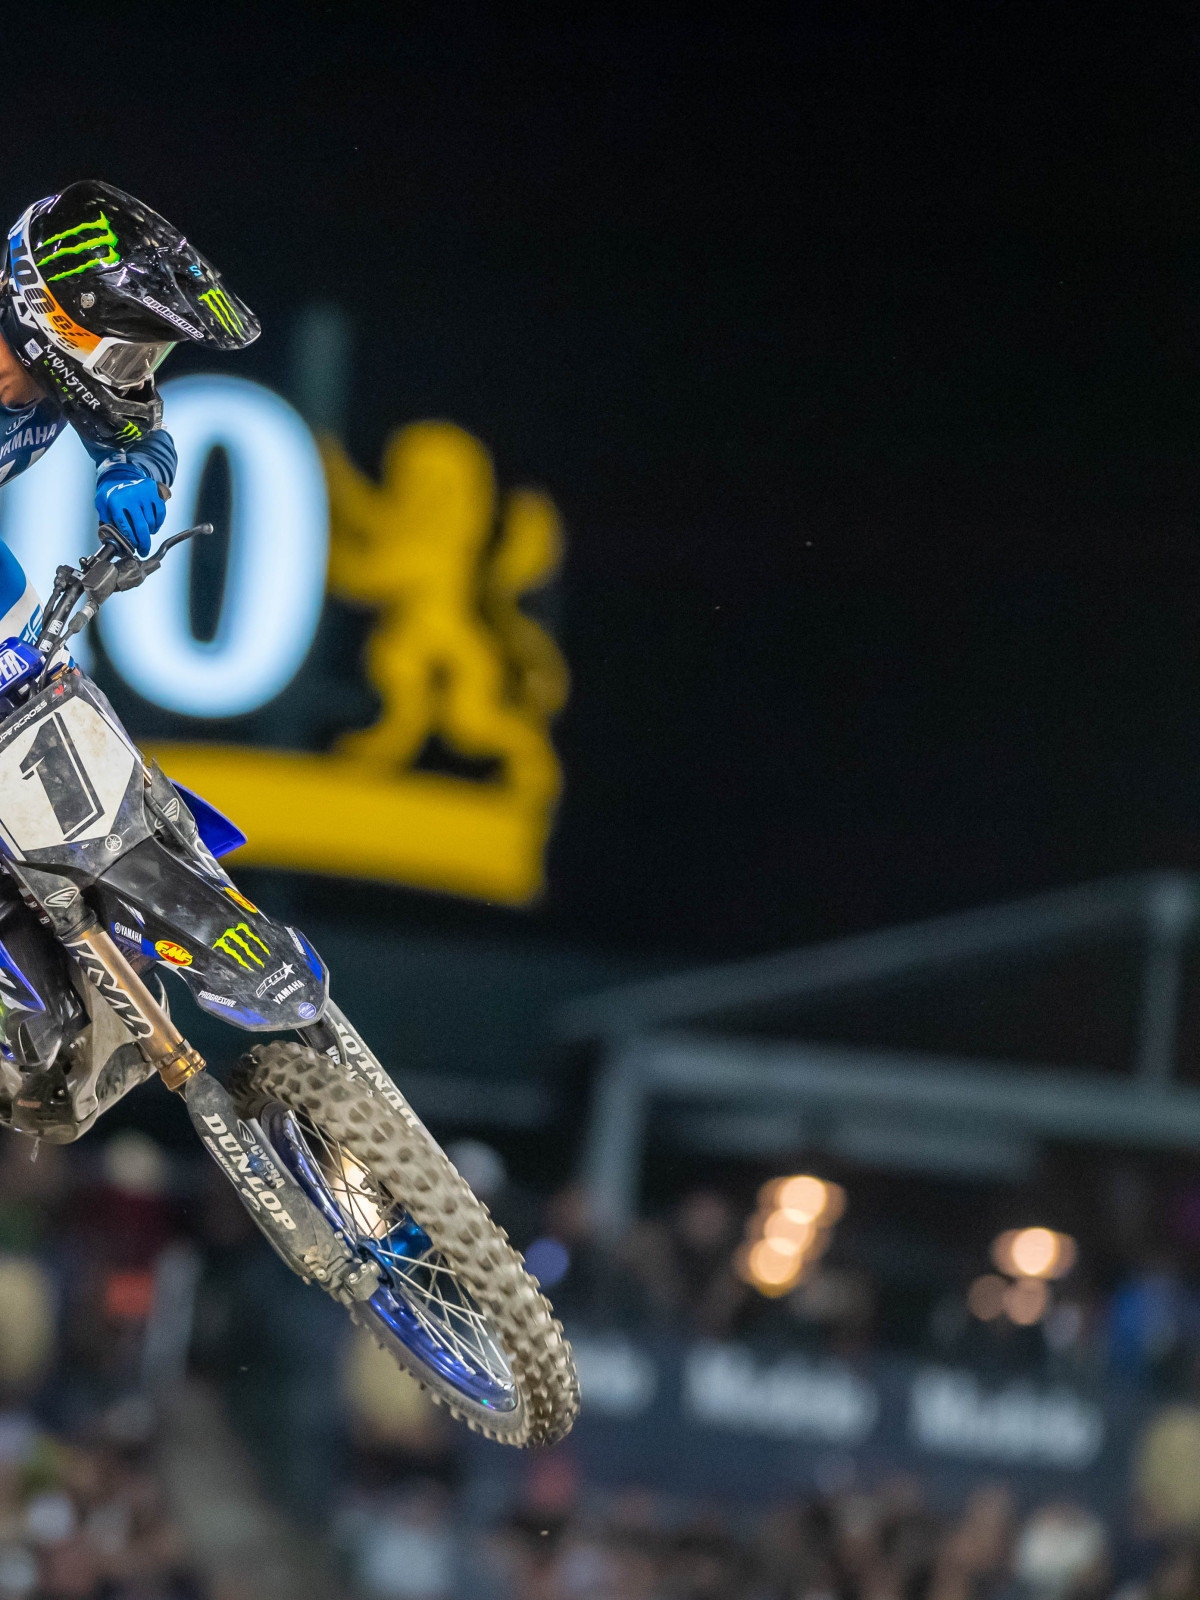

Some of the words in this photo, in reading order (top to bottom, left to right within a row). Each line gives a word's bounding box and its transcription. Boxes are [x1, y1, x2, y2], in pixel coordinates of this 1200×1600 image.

[43, 343, 101, 410] MONSTER
[0, 423, 58, 461] YAMAHA
[19, 711, 106, 842] 1
[121, 926, 143, 945] YAMAHA
[155, 943, 194, 963] FMF
[199, 990, 237, 1008] PROGRESSIVE
[273, 980, 305, 1006] YAMAHA
[201, 1112, 297, 1231] DUNLOP
[203, 1136, 241, 1183] BRAKING
